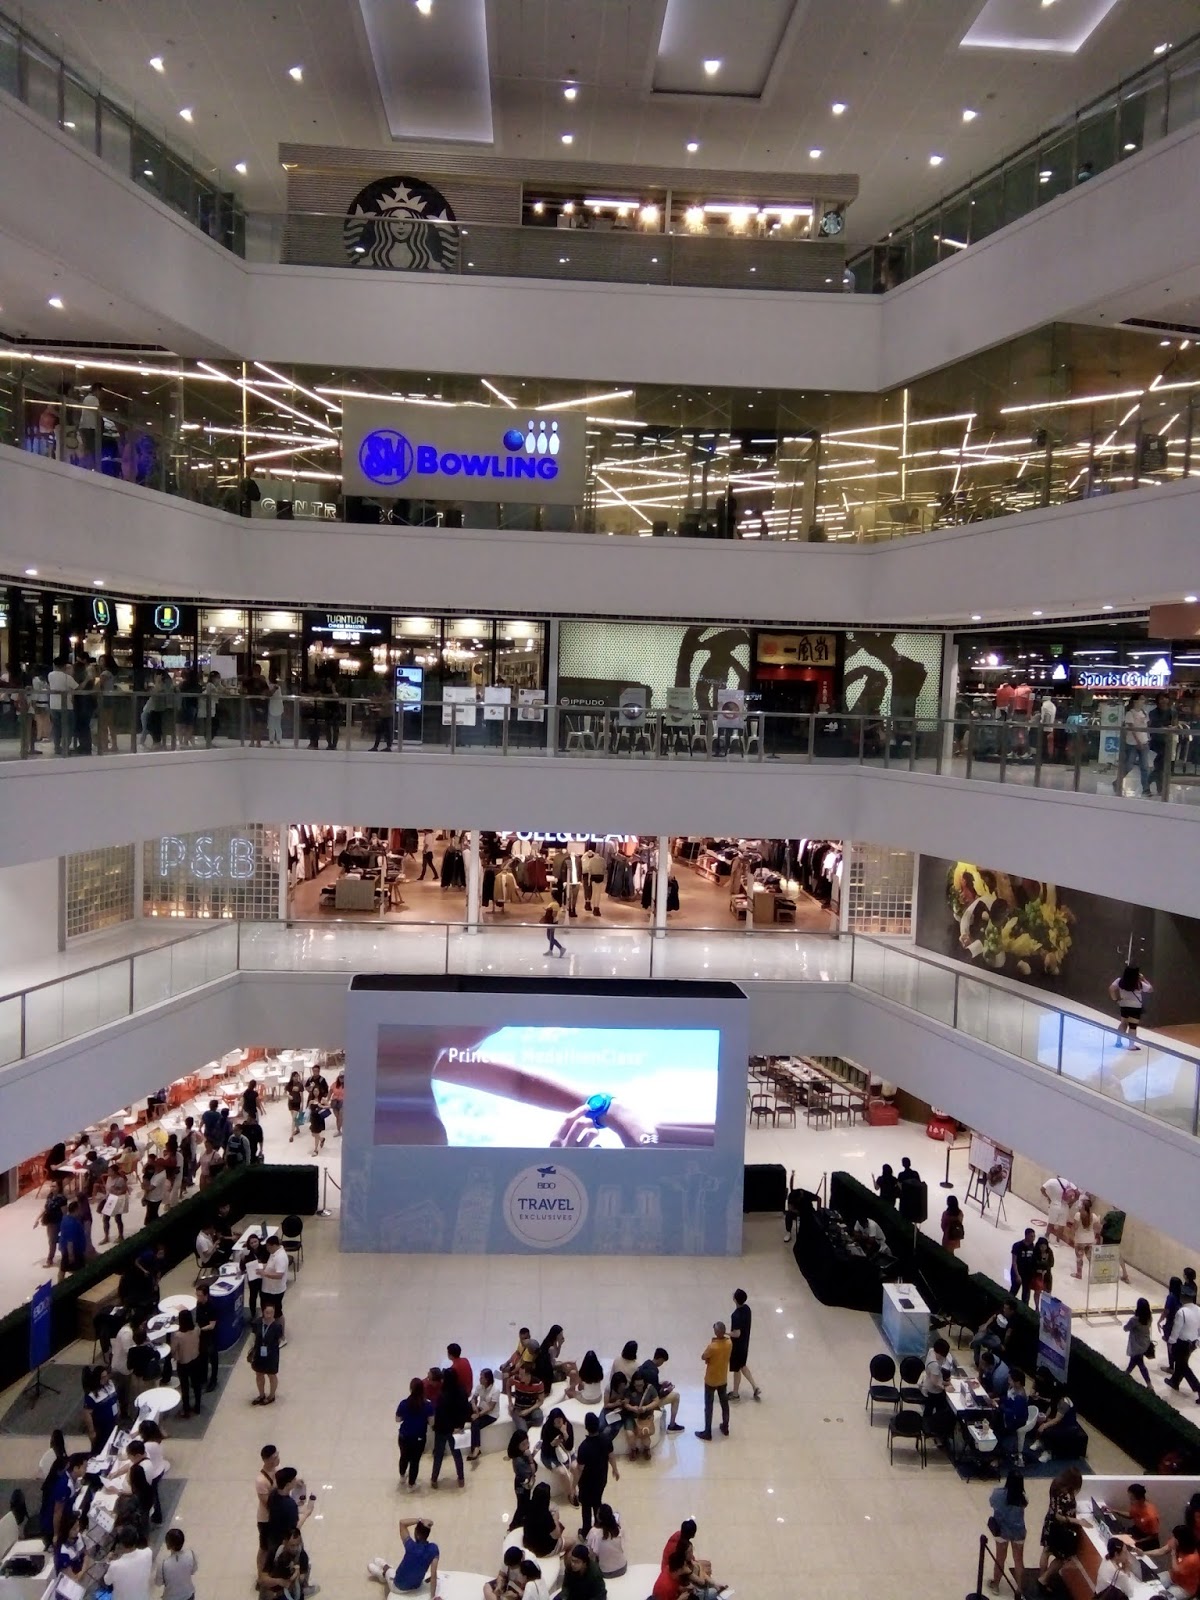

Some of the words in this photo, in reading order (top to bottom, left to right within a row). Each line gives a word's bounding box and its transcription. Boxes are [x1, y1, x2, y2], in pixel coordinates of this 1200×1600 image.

[417, 446, 560, 480] BOWLING
[326, 614, 368, 625] TUANTUAN
[161, 836, 256, 879] P&B
[537, 1182, 556, 1190] BDO
[518, 1198, 574, 1211] TRAVEL
